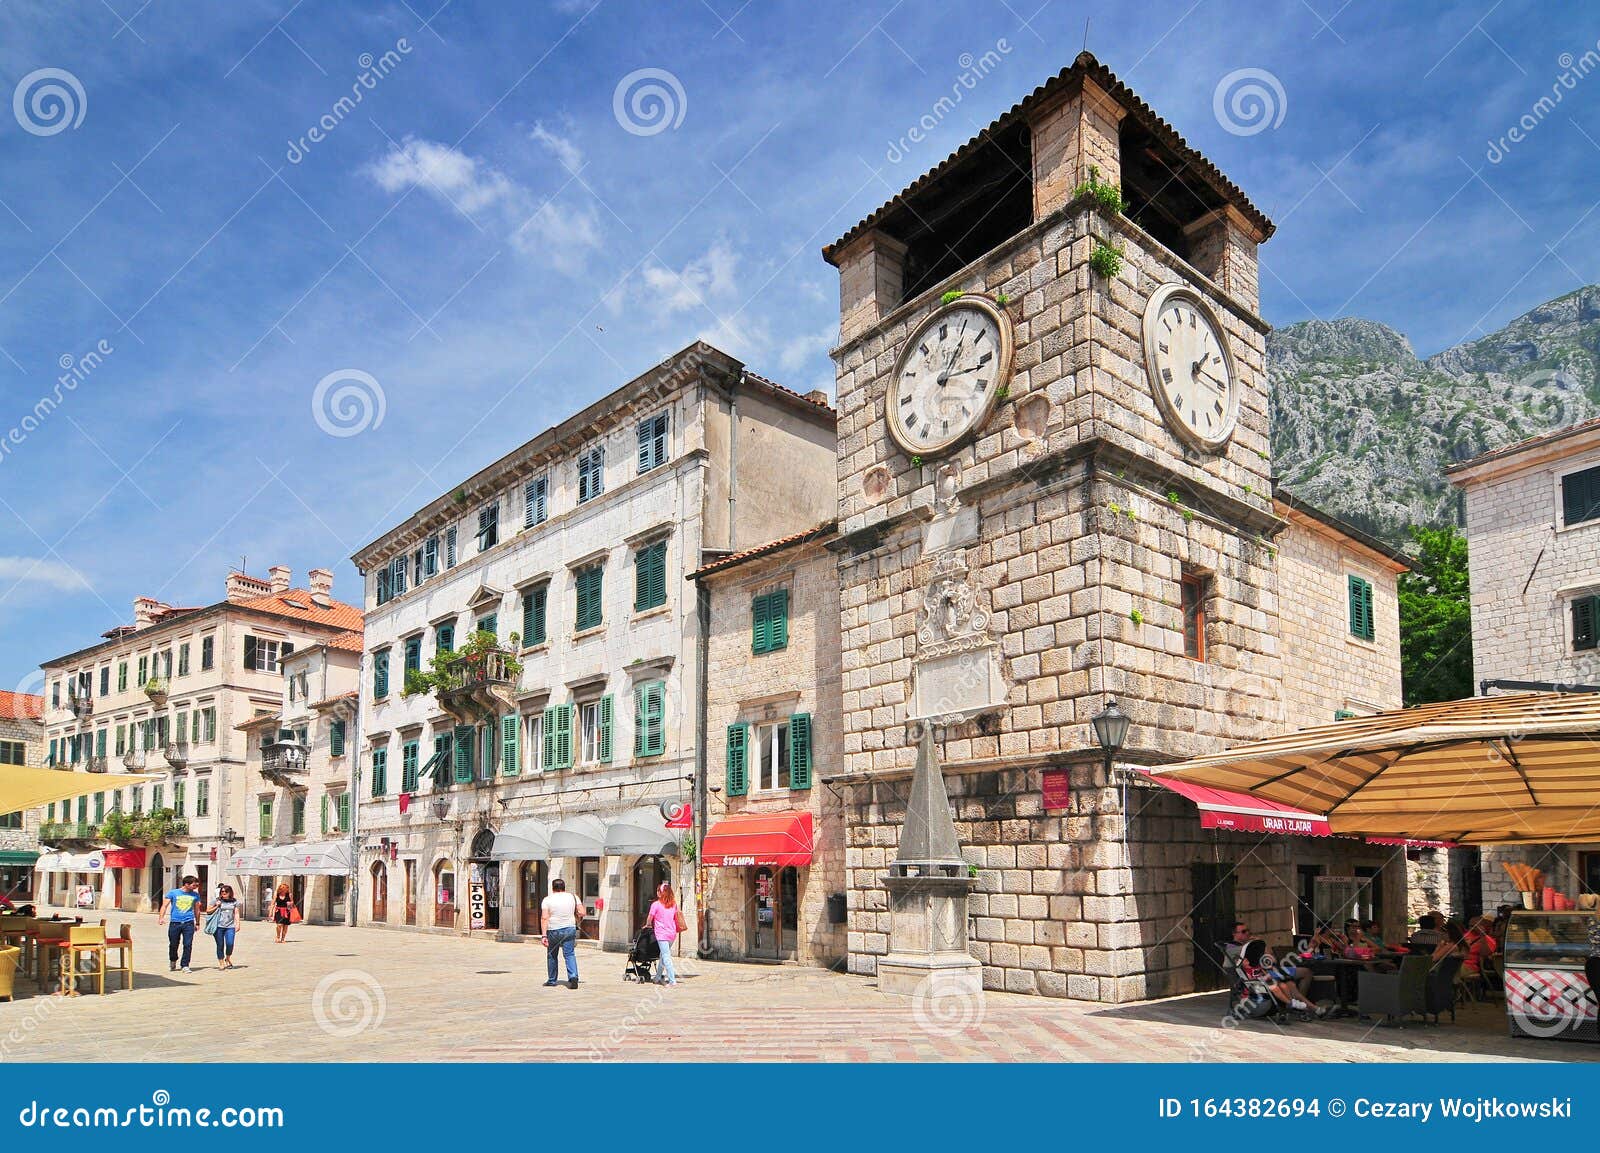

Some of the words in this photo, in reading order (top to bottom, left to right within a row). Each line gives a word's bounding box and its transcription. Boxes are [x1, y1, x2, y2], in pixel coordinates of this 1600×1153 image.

[1262, 817, 1284, 830] URAR
[1288, 820, 1313, 832] ZLATAR
[722, 855, 755, 867] ŠTAMPA
[471, 885, 484, 919] FOTO
